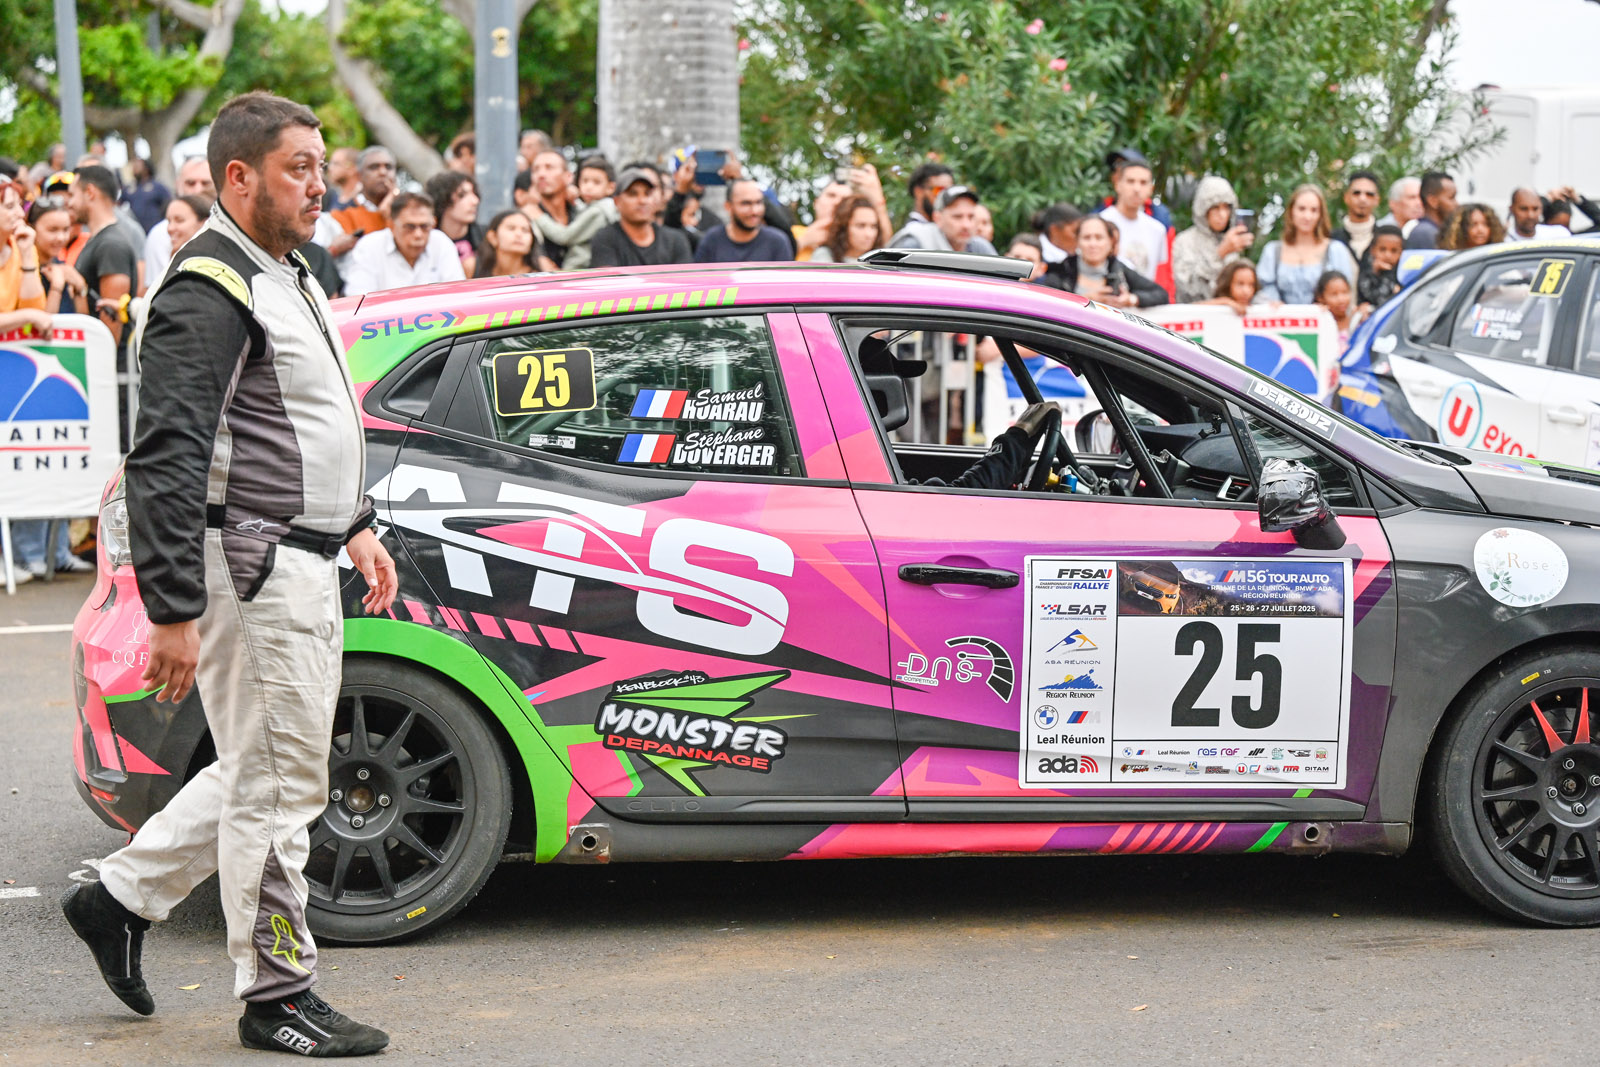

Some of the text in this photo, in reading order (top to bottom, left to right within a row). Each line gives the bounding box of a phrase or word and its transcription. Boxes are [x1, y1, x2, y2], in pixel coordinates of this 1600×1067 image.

[361, 313, 434, 340] STLC
[517, 353, 571, 409] 25
[695, 383, 762, 406] Samuel
[1448, 396, 1473, 437] U
[685, 426, 763, 452] Stéphane
[1507, 552, 1549, 571] Rose
[1057, 568, 1107, 579] FFSA
[1268, 573, 1300, 584] TOUR
[1299, 573, 1329, 584] AUTO
[1073, 582, 1110, 590] RALLYE
[1056, 604, 1107, 615] LSAR
[1170, 620, 1282, 730] 25
[599, 703, 785, 757] MONSTER
[1037, 734, 1105, 744] Leal Réunion
[607, 734, 769, 770] DEPANNAGE
[1038, 755, 1078, 773] ada
[626, 800, 700, 812] CLIO
[277, 1026, 317, 1055] GT2i
